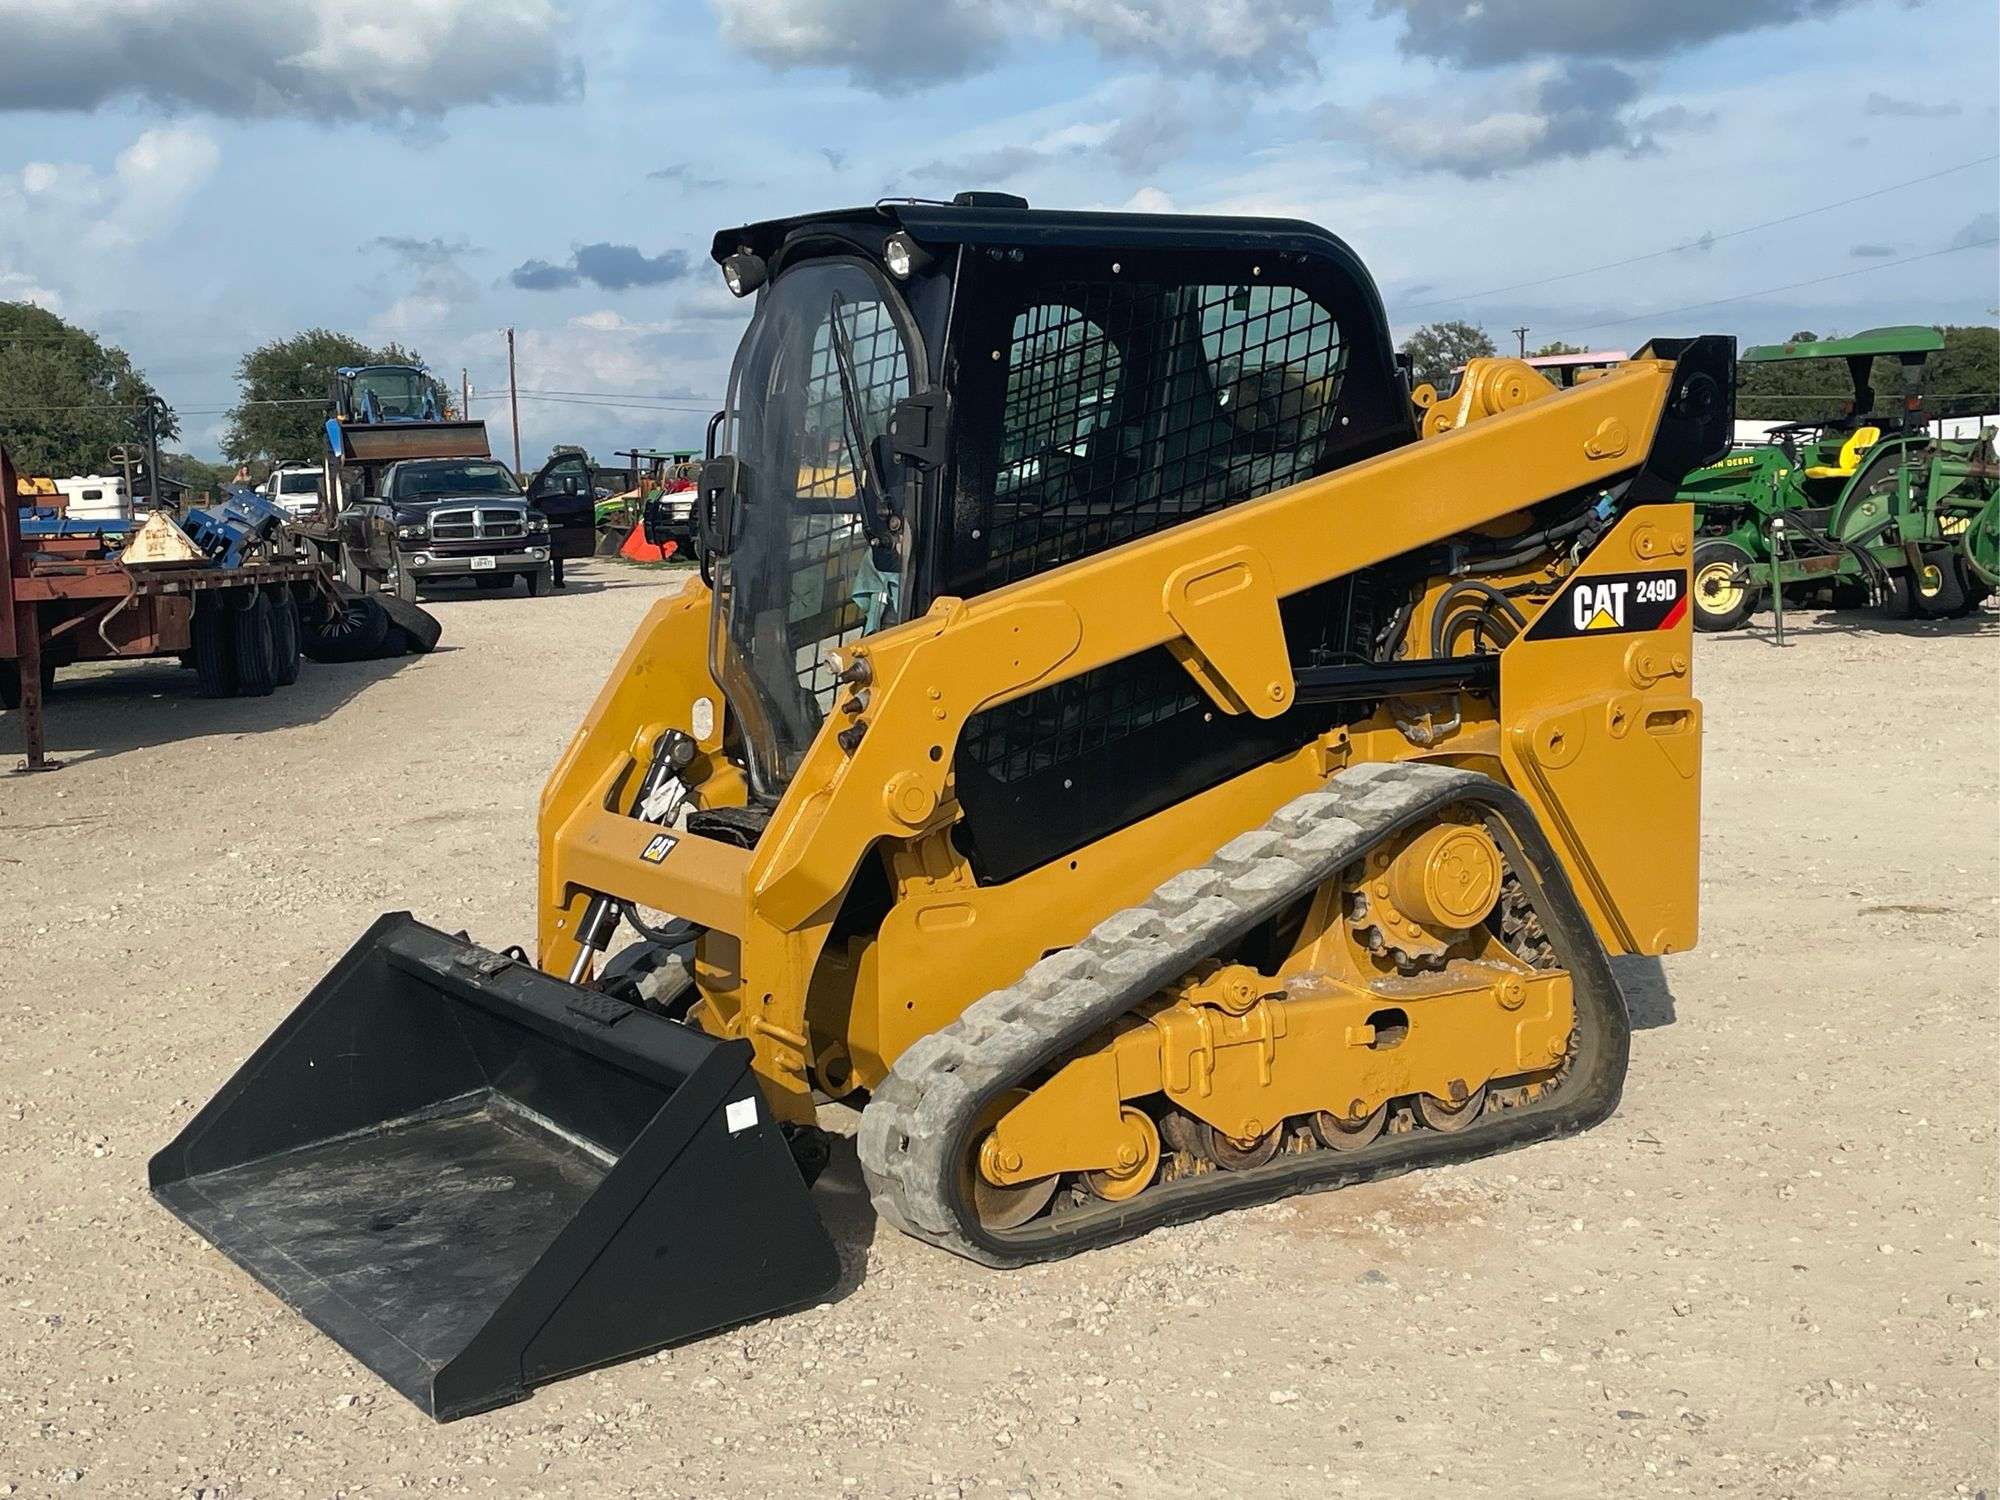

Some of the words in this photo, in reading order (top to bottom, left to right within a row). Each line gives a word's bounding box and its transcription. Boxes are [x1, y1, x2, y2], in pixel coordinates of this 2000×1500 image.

[1726, 456, 1754, 467] DEERE
[1573, 583, 1628, 631] CAT
[1636, 579, 1677, 603] 249D
[643, 836, 676, 861] CAT
